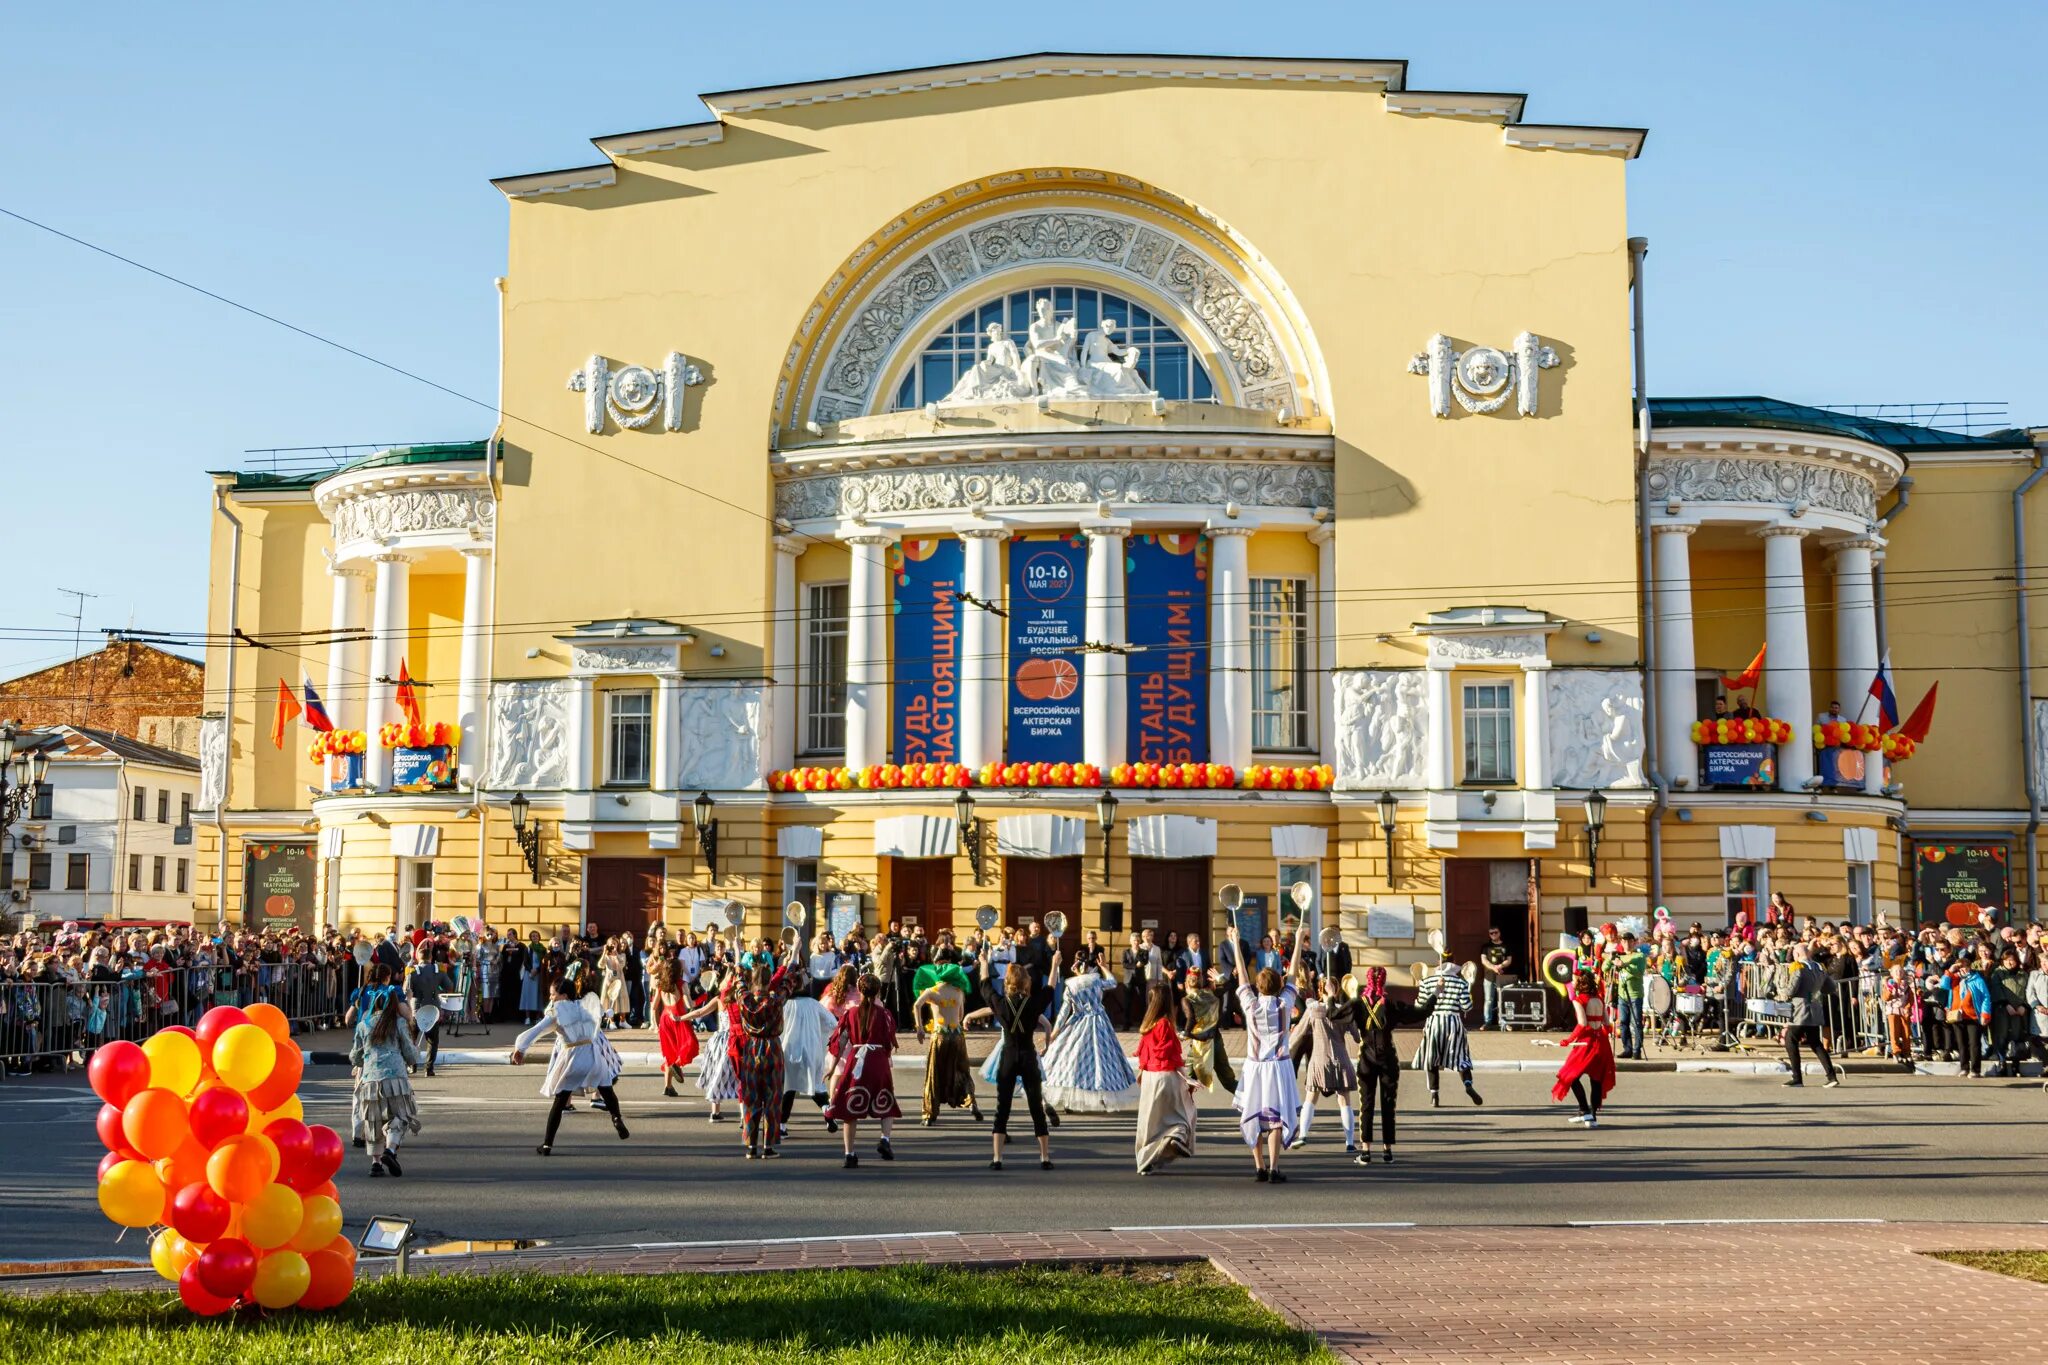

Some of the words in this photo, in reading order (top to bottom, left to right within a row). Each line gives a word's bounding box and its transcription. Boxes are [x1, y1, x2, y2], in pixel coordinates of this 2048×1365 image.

[1028, 566, 1068, 579] 10-16
[1028, 580, 1047, 588] МАЯ
[1049, 580, 1068, 588] 2021
[1041, 609, 1055, 619] XII
[1027, 625, 1068, 635] БУДУЩЕЕ
[1018, 635, 1078, 645] ТЕАТРАЛЬНОЙ
[1014, 705, 1080, 715] ВСЕРОССИЙСКАЯ
[1022, 717, 1072, 726] АКТЕРСКАЯ
[1030, 728, 1062, 736] БИРЖА
[1709, 750, 1763, 759] ВСЕРОССИЙСКАЯ
[1966, 849, 1989, 858] 10-16
